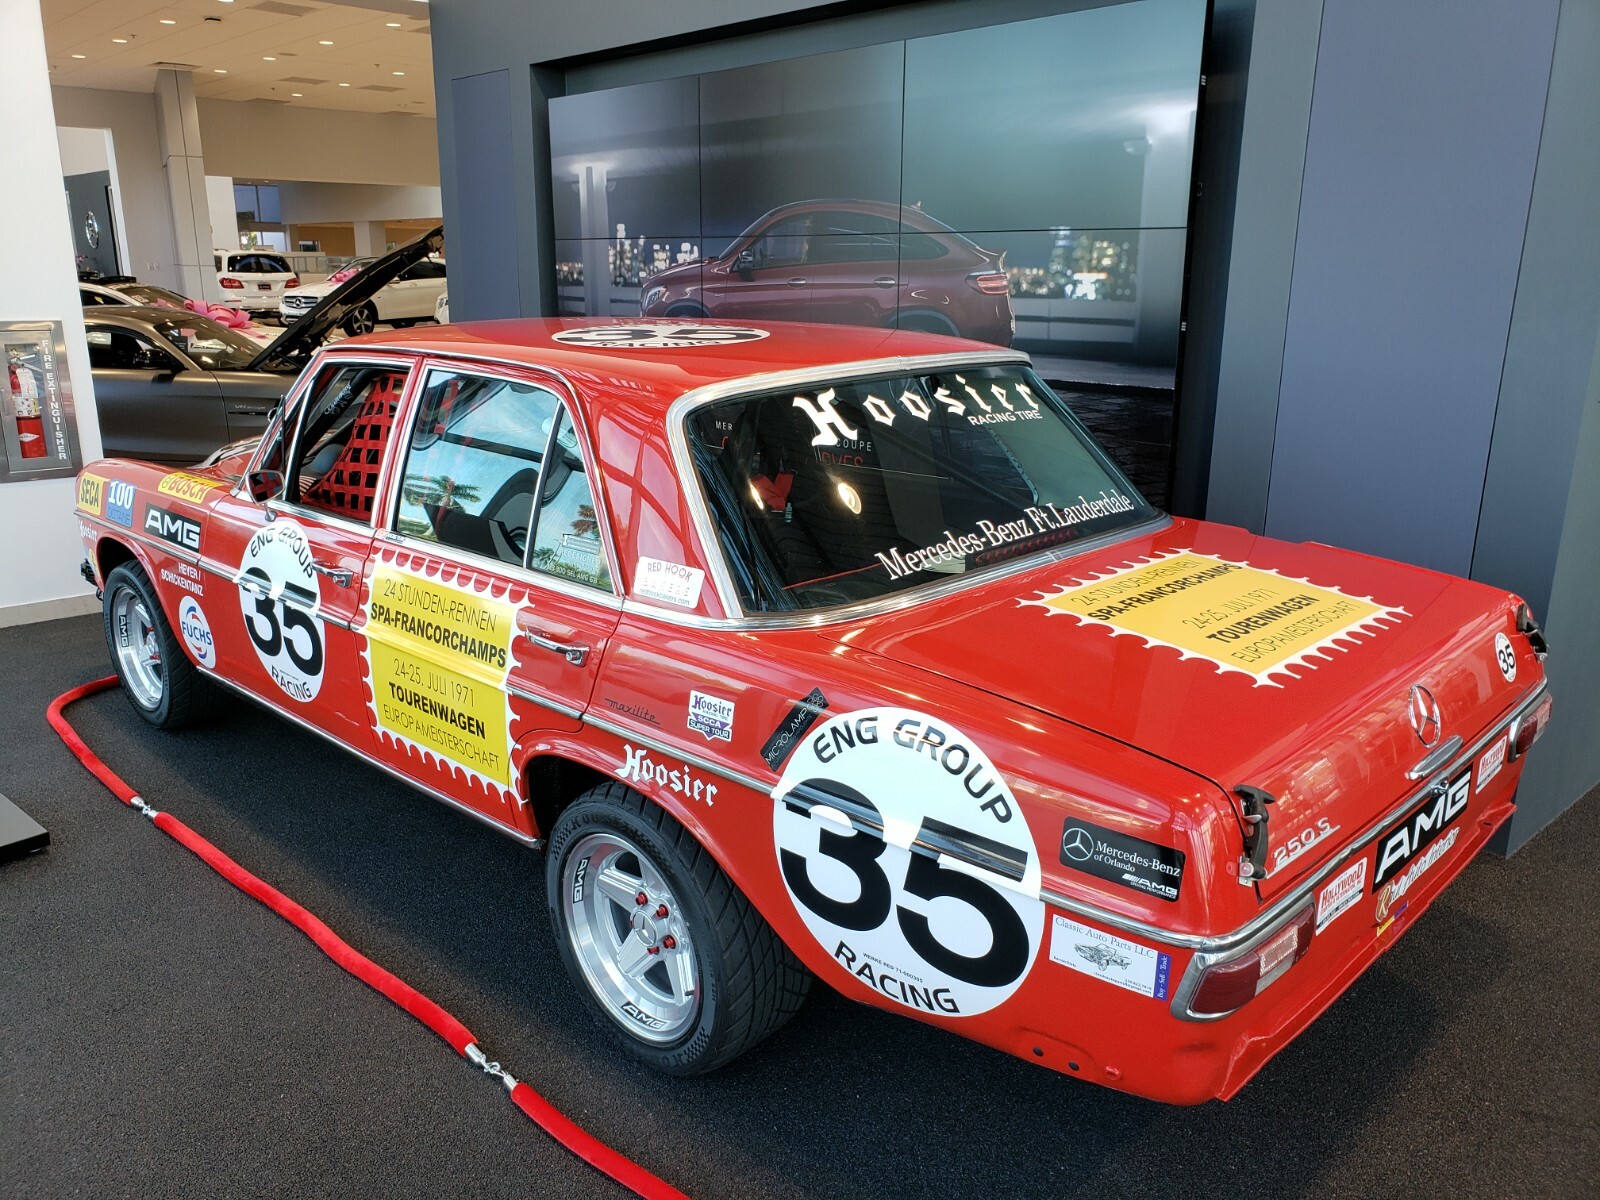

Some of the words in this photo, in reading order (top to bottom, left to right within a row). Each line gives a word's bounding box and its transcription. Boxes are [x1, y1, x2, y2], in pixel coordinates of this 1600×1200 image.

[557, 328, 762, 341] 35
[42, 340, 53, 370] FIRE
[46, 373, 67, 460] EXTINGUISHER
[793, 374, 1040, 446] Hoosier
[967, 412, 1016, 426] RACING
[1018, 409, 1043, 421] TIRE
[836, 438, 872, 452] COUPE
[80, 478, 99, 508] SECA
[108, 480, 134, 510] 100
[168, 476, 210, 501] BOSCH
[145, 508, 200, 548] AMG
[250, 527, 276, 558] ENG
[278, 526, 314, 579] GROUP
[874, 518, 1032, 580] Mercedes-Benz
[161, 569, 204, 597] SCHICKENTANZ
[647, 562, 661, 573] RED
[665, 563, 692, 582] HOOK
[384, 578, 396, 599] 24
[398, 583, 498, 633] STUNDEN-RENNEN
[1071, 594, 1100, 606] 24
[1087, 563, 1243, 621] SPA-FRANCORCHAMPS
[1221, 597, 1248, 613] JULI
[1243, 588, 1280, 608] 1971
[119, 615, 129, 647] AMG
[182, 621, 212, 645] FUCHS
[243, 567, 323, 676] 35
[371, 601, 506, 668] SPA-FRANCORCHAMPS
[1206, 594, 1320, 643] TOURENWAGEN
[1498, 644, 1515, 674] 35
[271, 664, 313, 699] RACING
[393, 658, 424, 684] 24-25.
[427, 671, 447, 697] JULI
[450, 683, 474, 708] 1971
[389, 681, 485, 740] TOURENWAGEN
[606, 698, 659, 724] maxilite
[692, 695, 731, 716] Hoosier
[698, 716, 721, 728] SCCA
[690, 720, 710, 732] SUPER
[711, 728, 729, 738] TOUR
[765, 708, 808, 764] MICROLAMP
[614, 744, 718, 807] Hoosier
[813, 716, 878, 763] ENG
[893, 718, 1013, 824] GROUP
[1273, 831, 1316, 867] 250
[1315, 817, 1332, 840] S
[1375, 771, 1471, 885] AMG
[1094, 854, 1103, 862] of
[1105, 856, 1135, 872] Orlando
[1095, 840, 1181, 877] Mercedes-Benz
[573, 858, 589, 903] AMG
[780, 778, 1030, 987] 35
[1138, 878, 1178, 896] AMG
[1055, 916, 1084, 934] Classic
[1085, 928, 1108, 943] Auto
[1110, 936, 1132, 952] Parts
[1134, 944, 1155, 959] LLC
[834, 939, 960, 1014] RACING
[1160, 955, 1168, 970] Trade
[1157, 987, 1166, 998] Buy
[623, 1004, 669, 1029] AMG
